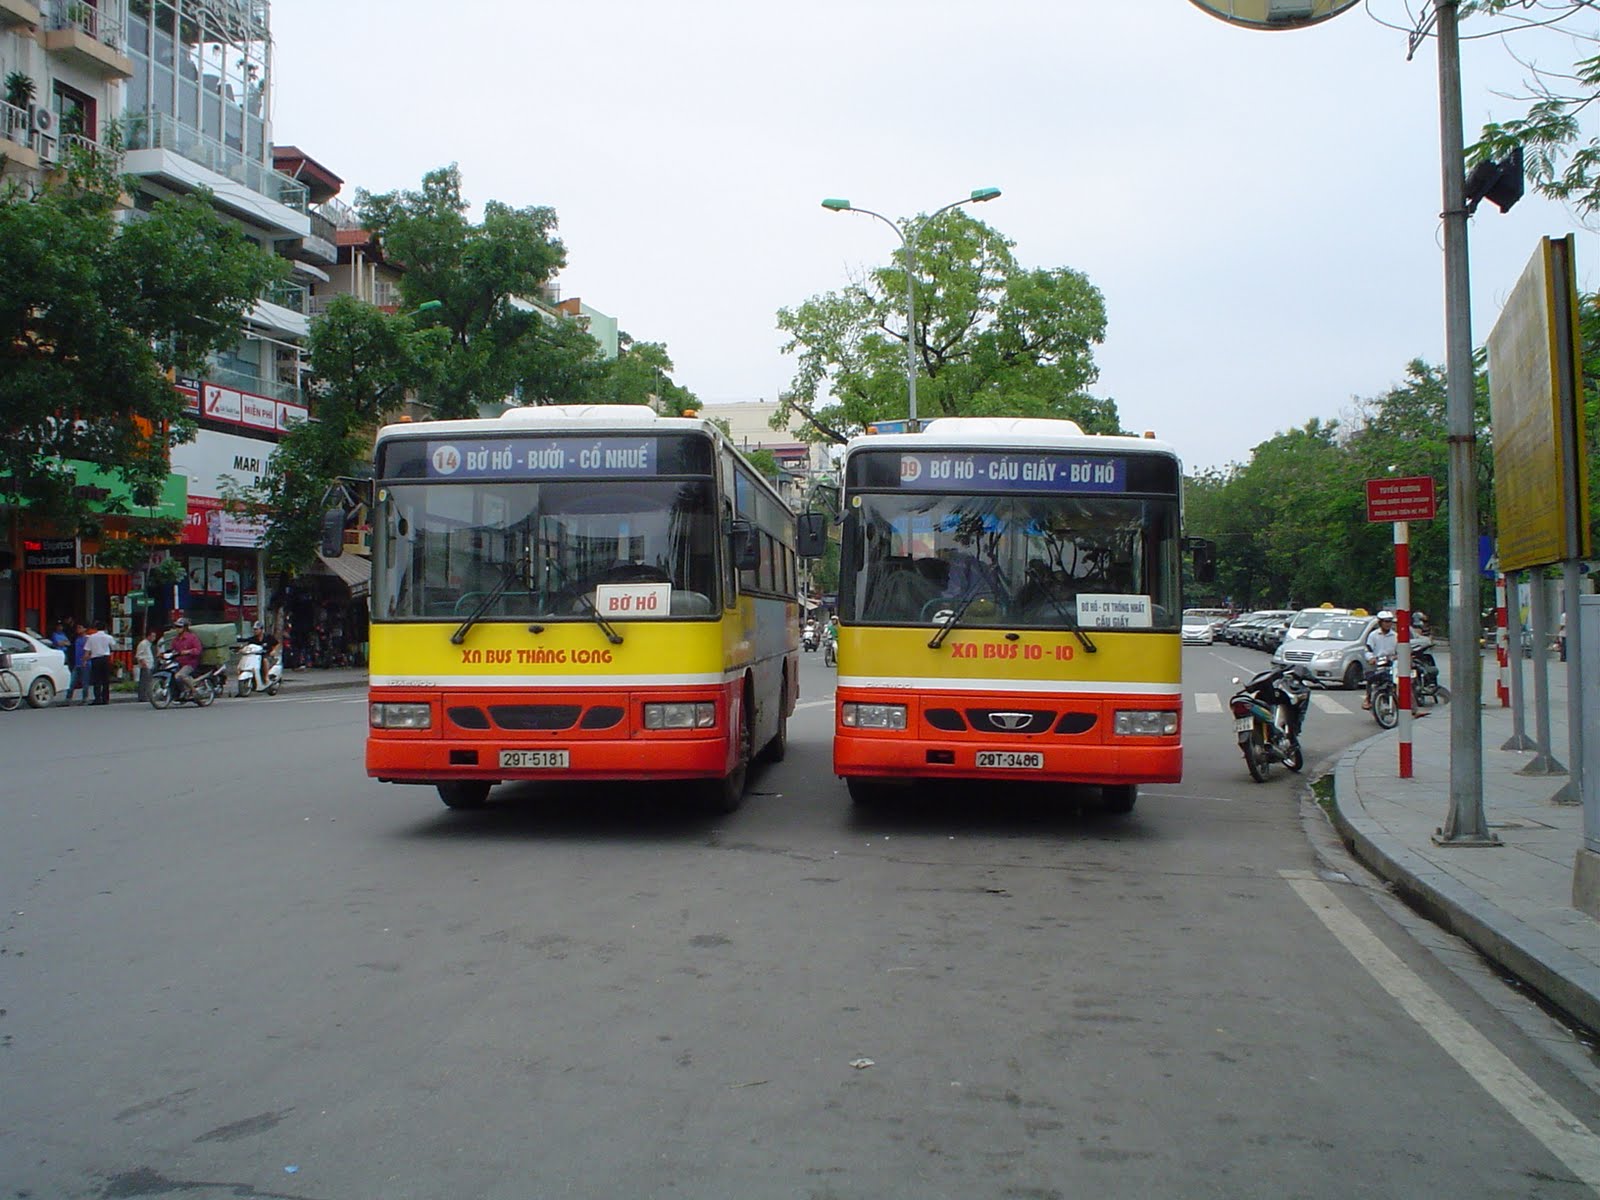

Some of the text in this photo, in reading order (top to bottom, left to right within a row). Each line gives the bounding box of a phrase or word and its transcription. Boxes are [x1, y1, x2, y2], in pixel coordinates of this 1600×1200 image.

[436, 451, 457, 470] 14
[467, 446, 489, 471] BỜ
[492, 444, 513, 470] HỒ
[528, 442, 564, 470] BƯỞI
[605, 442, 649, 469] NHUẾ
[901, 461, 918, 476] 09
[930, 455, 951, 479] BỜ
[954, 455, 975, 479] HỒ
[988, 455, 1019, 480] CẦU
[1022, 457, 1057, 482] GIẤY
[1071, 459, 1092, 483] BỜ
[1094, 459, 1115, 484] HỒ
[462, 646, 613, 664] XN BUS THĂNG LONG
[951, 643, 978, 659] XN
[983, 643, 1019, 660] BUS
[1023, 644, 1043, 661] 10
[1055, 645, 1075, 661] 10
[503, 752, 564, 766] 29T-5181
[979, 753, 1039, 767] 29T-3486
